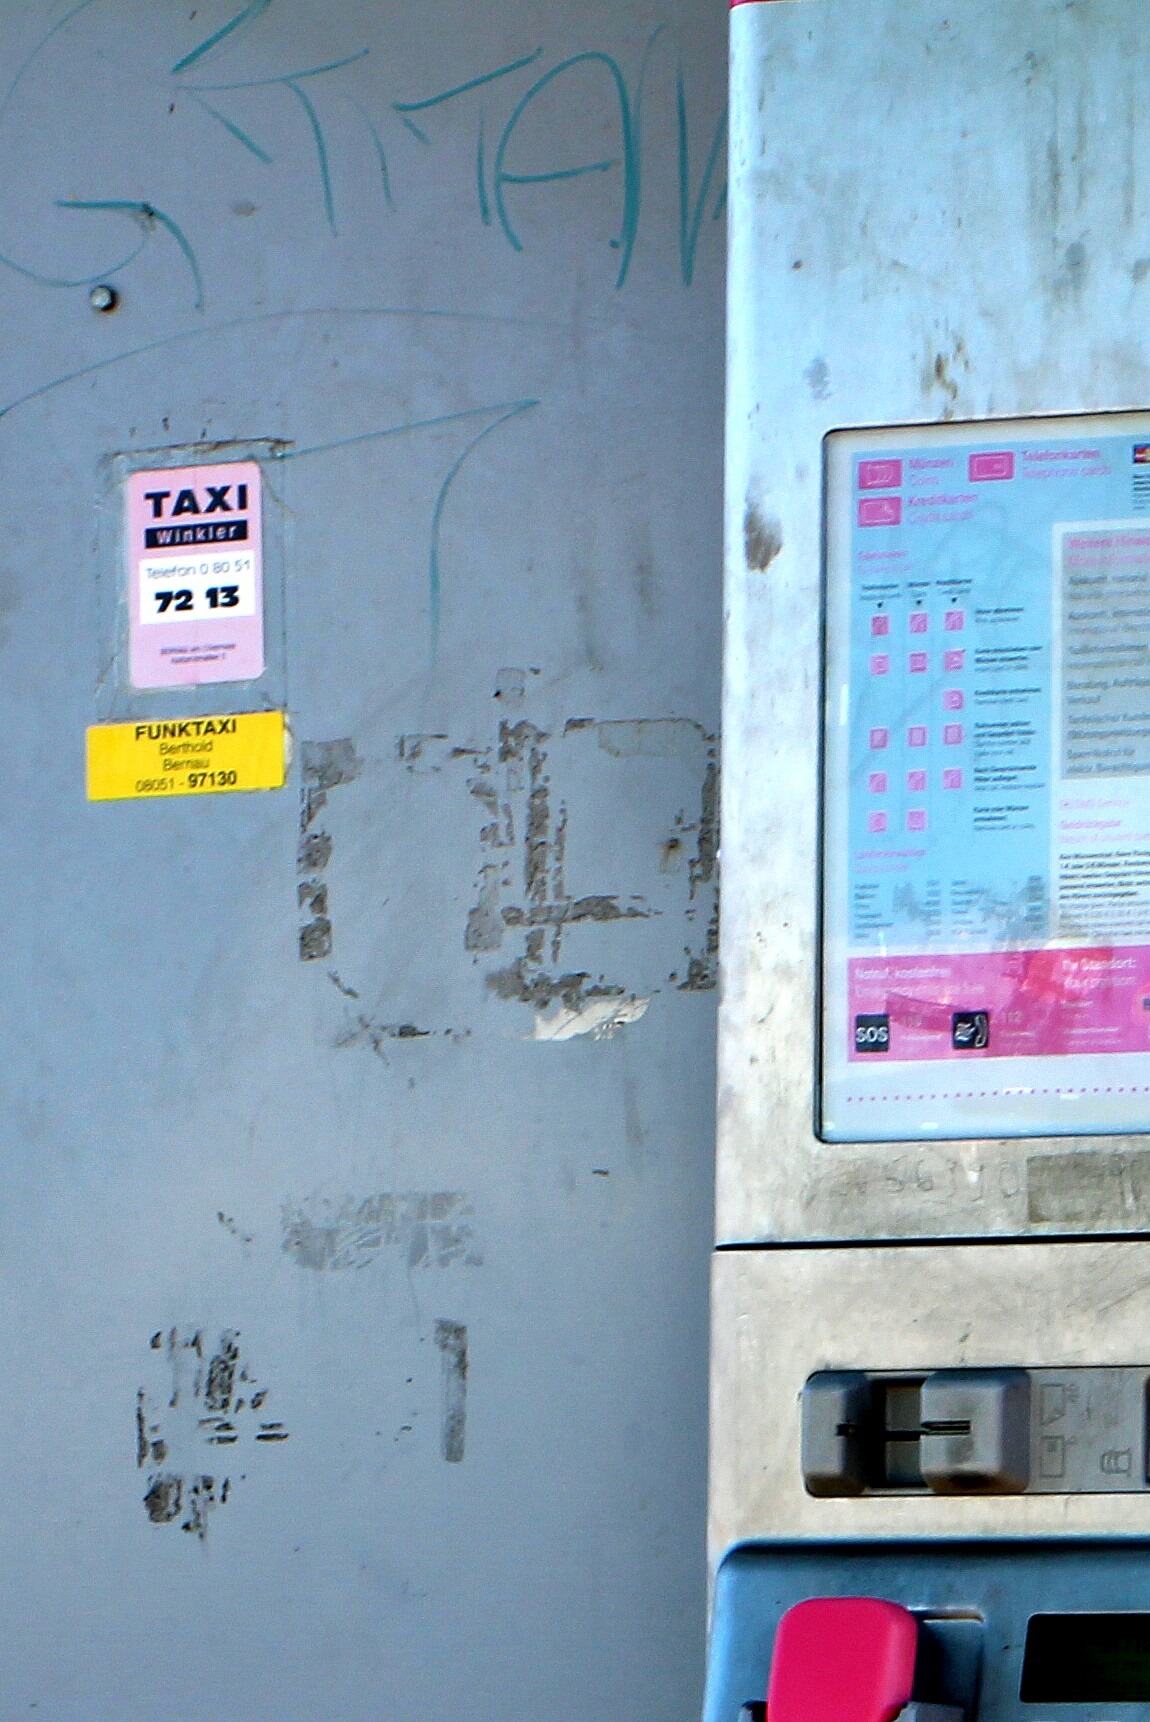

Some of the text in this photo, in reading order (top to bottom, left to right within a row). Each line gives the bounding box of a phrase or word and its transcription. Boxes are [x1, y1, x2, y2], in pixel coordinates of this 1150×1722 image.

[144, 483, 248, 519] TAXI
[155, 524, 237, 545] Winkler
[146, 559, 250, 580] Telefon 0 80 51
[154, 585, 240, 614] 72 13
[135, 718, 237, 741] FUNKTAXI
[159, 740, 214, 756] Berthold
[163, 758, 210, 772] Bernau
[136, 777, 175, 793] 08051
[187, 770, 237, 788] 97130
[855, 1026, 889, 1043] SOS
